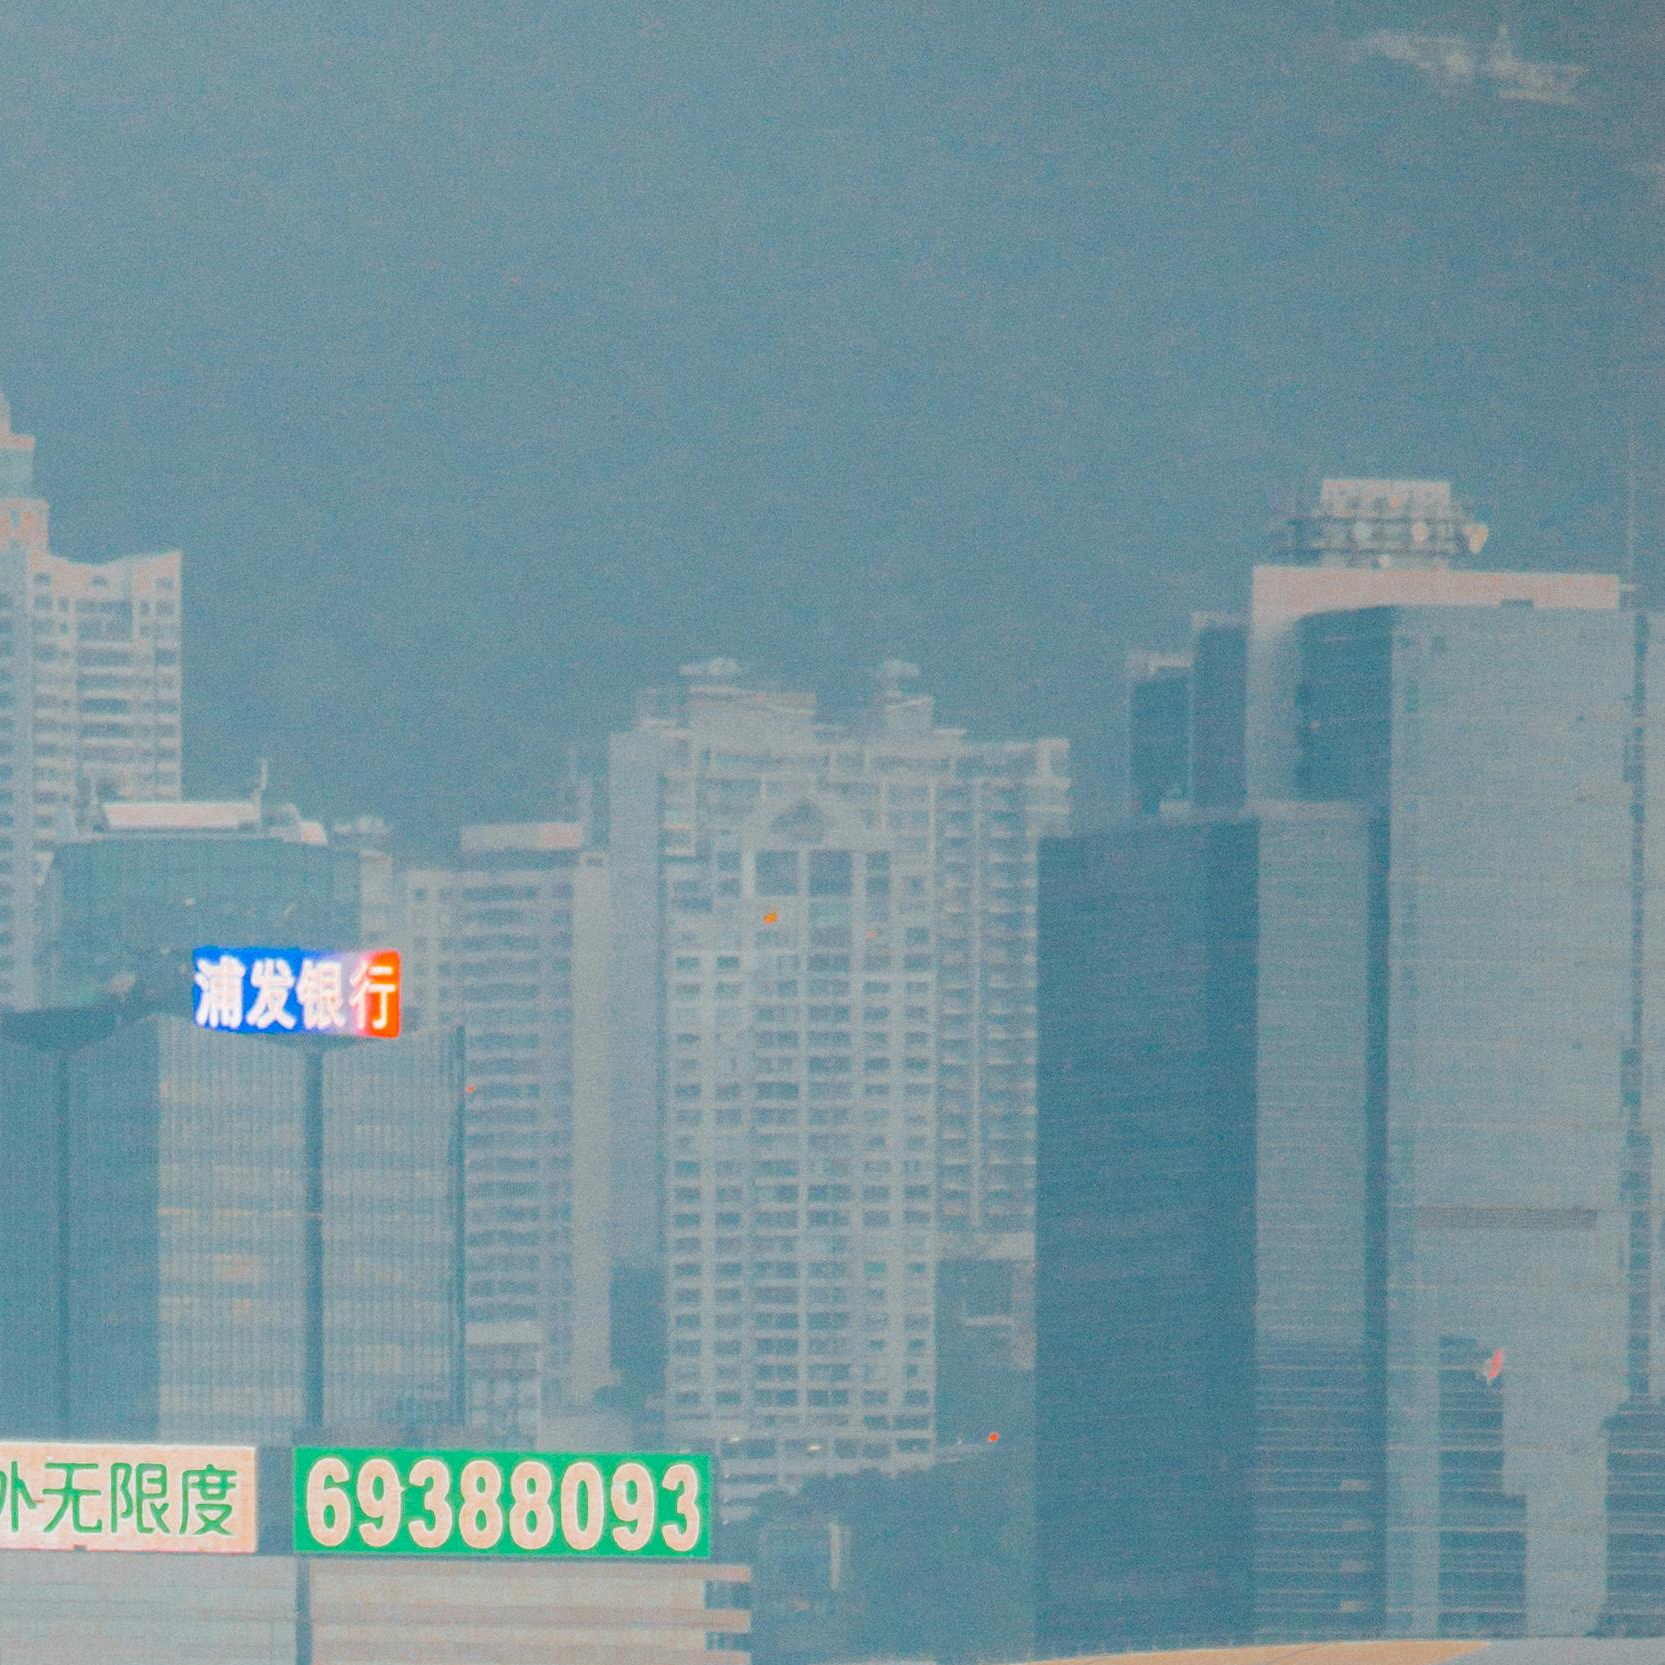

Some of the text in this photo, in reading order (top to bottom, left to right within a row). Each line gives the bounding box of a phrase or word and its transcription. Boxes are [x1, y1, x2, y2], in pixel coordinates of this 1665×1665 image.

[193, 954, 397, 1031] 浦发银行
[305, 1456, 701, 1552] 69388093
